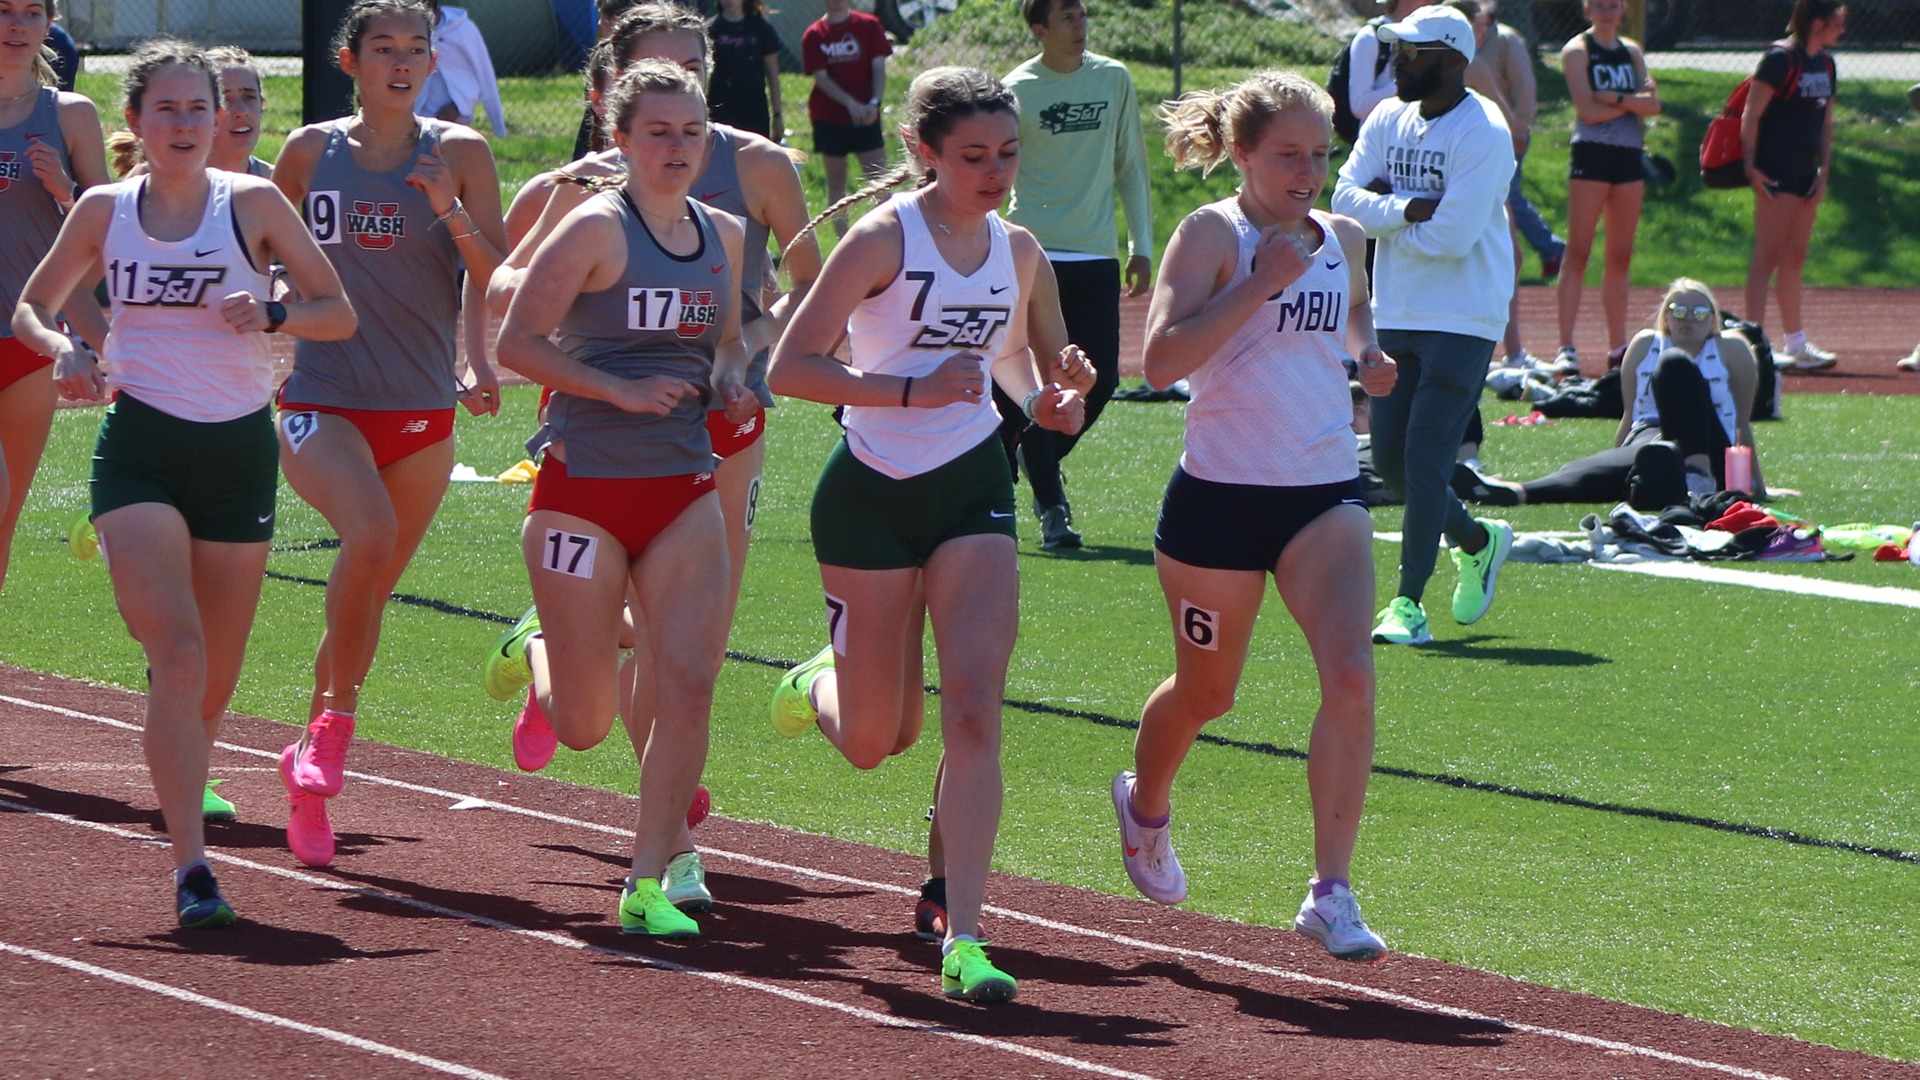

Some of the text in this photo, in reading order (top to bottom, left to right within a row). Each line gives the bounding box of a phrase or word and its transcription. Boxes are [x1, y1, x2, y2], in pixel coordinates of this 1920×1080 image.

[1064, 102, 1108, 123] S&T
[313, 194, 335, 241] 9
[346, 213, 405, 236] WASH
[109, 259, 138, 299] 11
[905, 271, 935, 321] 7
[632, 290, 673, 328] 17
[911, 306, 1010, 348] S&T
[1277, 291, 1341, 332] MBU
[288, 412, 313, 444] 9
[747, 480, 759, 526] 8
[549, 532, 590, 574] 17
[825, 595, 843, 645] 7
[1184, 606, 1213, 646] 6
